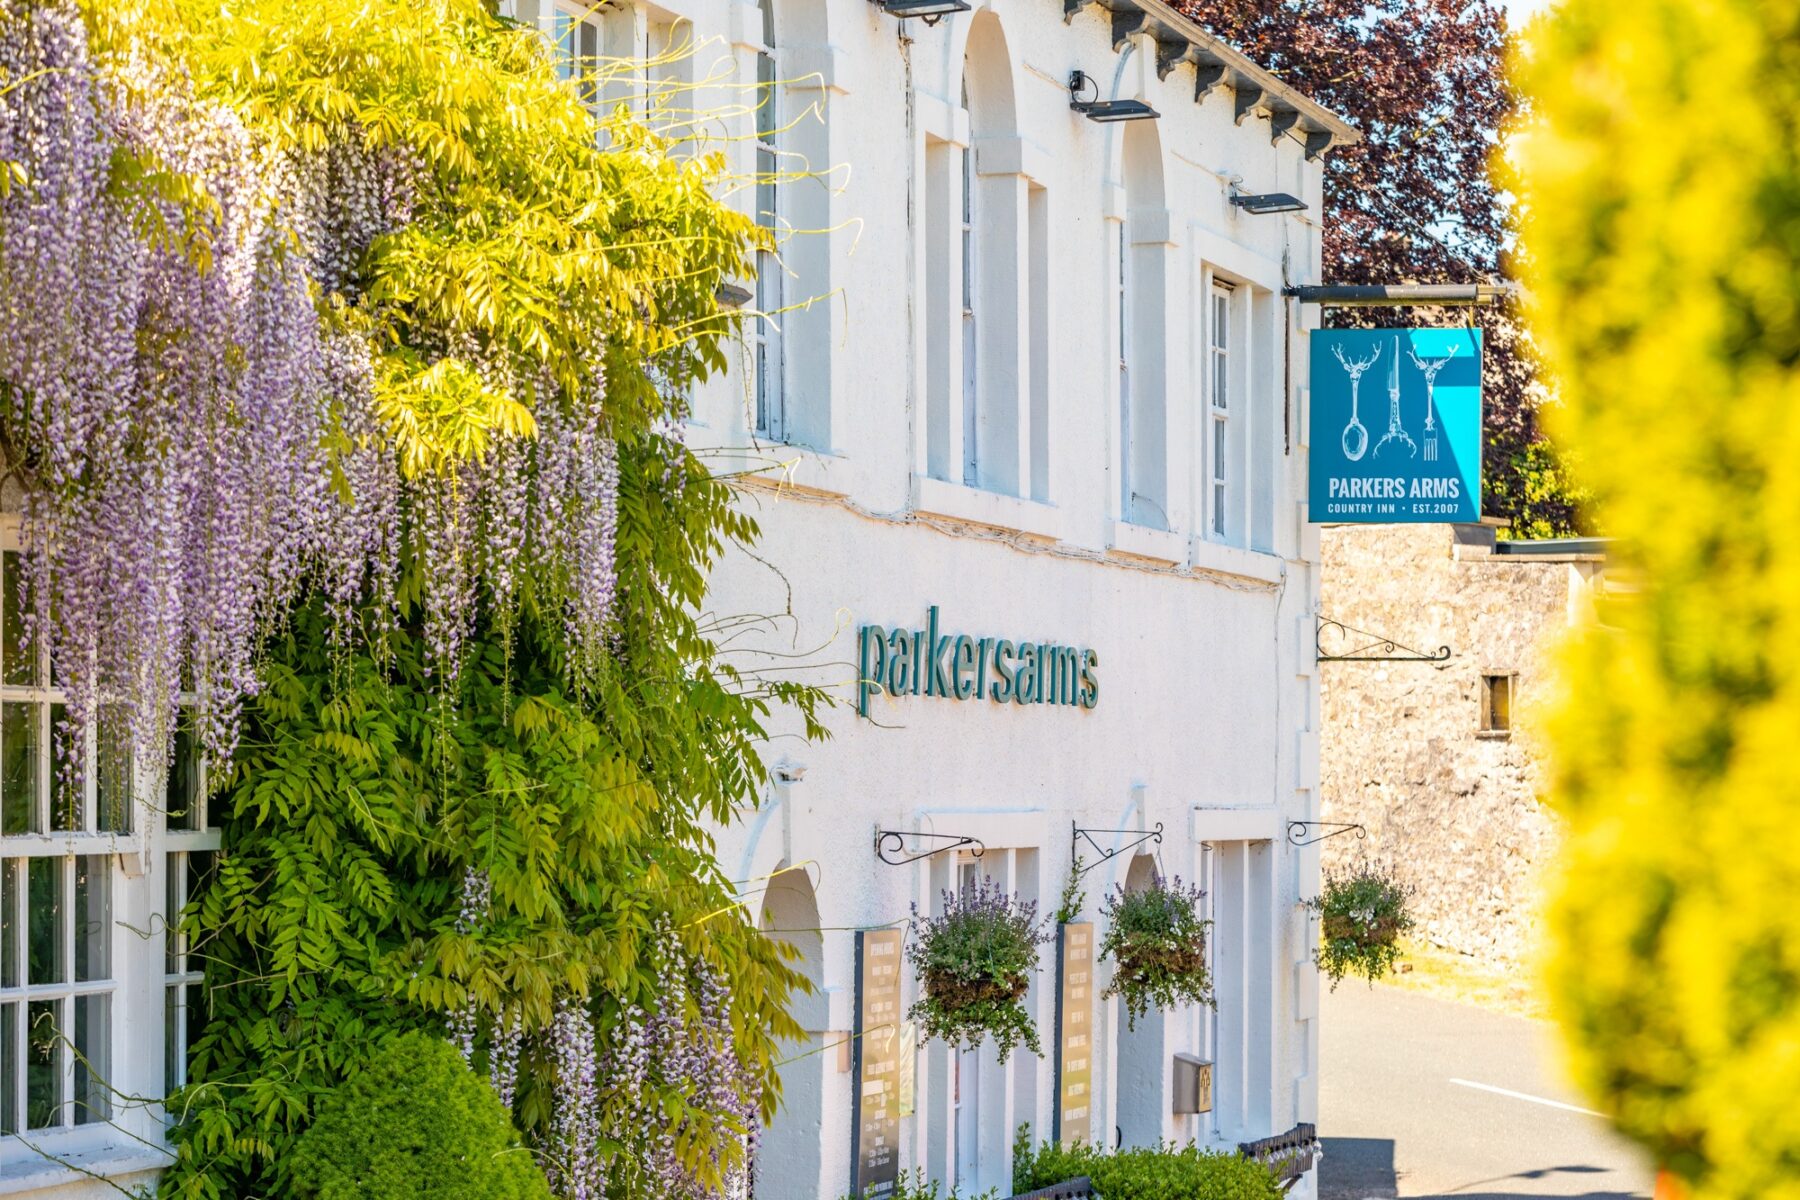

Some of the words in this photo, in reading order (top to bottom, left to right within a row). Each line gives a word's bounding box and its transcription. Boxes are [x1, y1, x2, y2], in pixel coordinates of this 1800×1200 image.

[1329, 477, 1406, 499] PARKERS
[1409, 477, 1460, 499] ARMS
[1327, 503, 1373, 514] COUNTRY
[1377, 503, 1395, 514] INN
[1412, 503, 1459, 514] EST.2007
